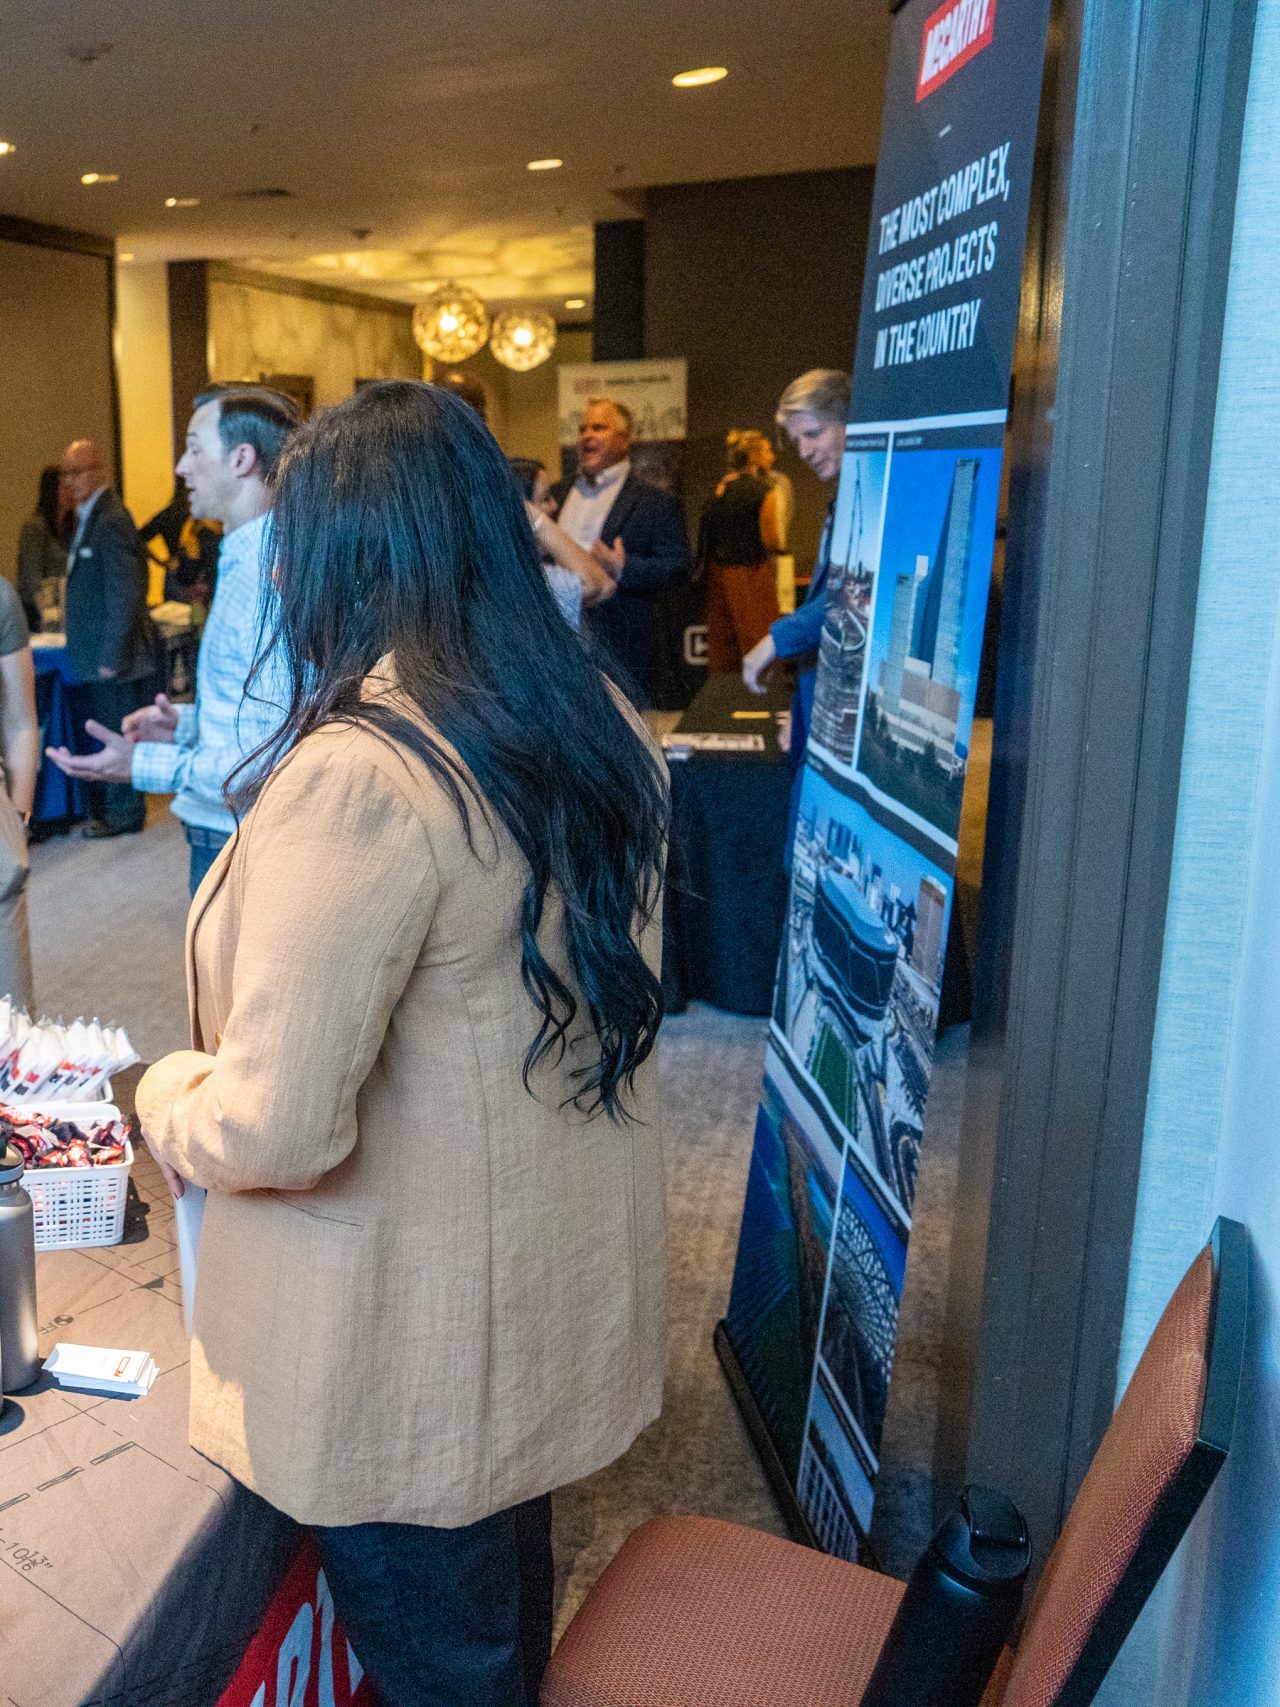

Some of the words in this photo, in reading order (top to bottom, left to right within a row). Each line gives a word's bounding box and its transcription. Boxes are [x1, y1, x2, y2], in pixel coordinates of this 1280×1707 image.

[878, 206, 901, 255] THE
[898, 186, 939, 245] MOST
[936, 141, 1010, 226] COMPLEX,
[875, 255, 927, 313] DIVERSE
[924, 220, 998, 294] PROJECTS
[874, 328, 889, 369] IN
[887, 320, 918, 367] THE
[916, 298, 982, 360] COUNTRY
